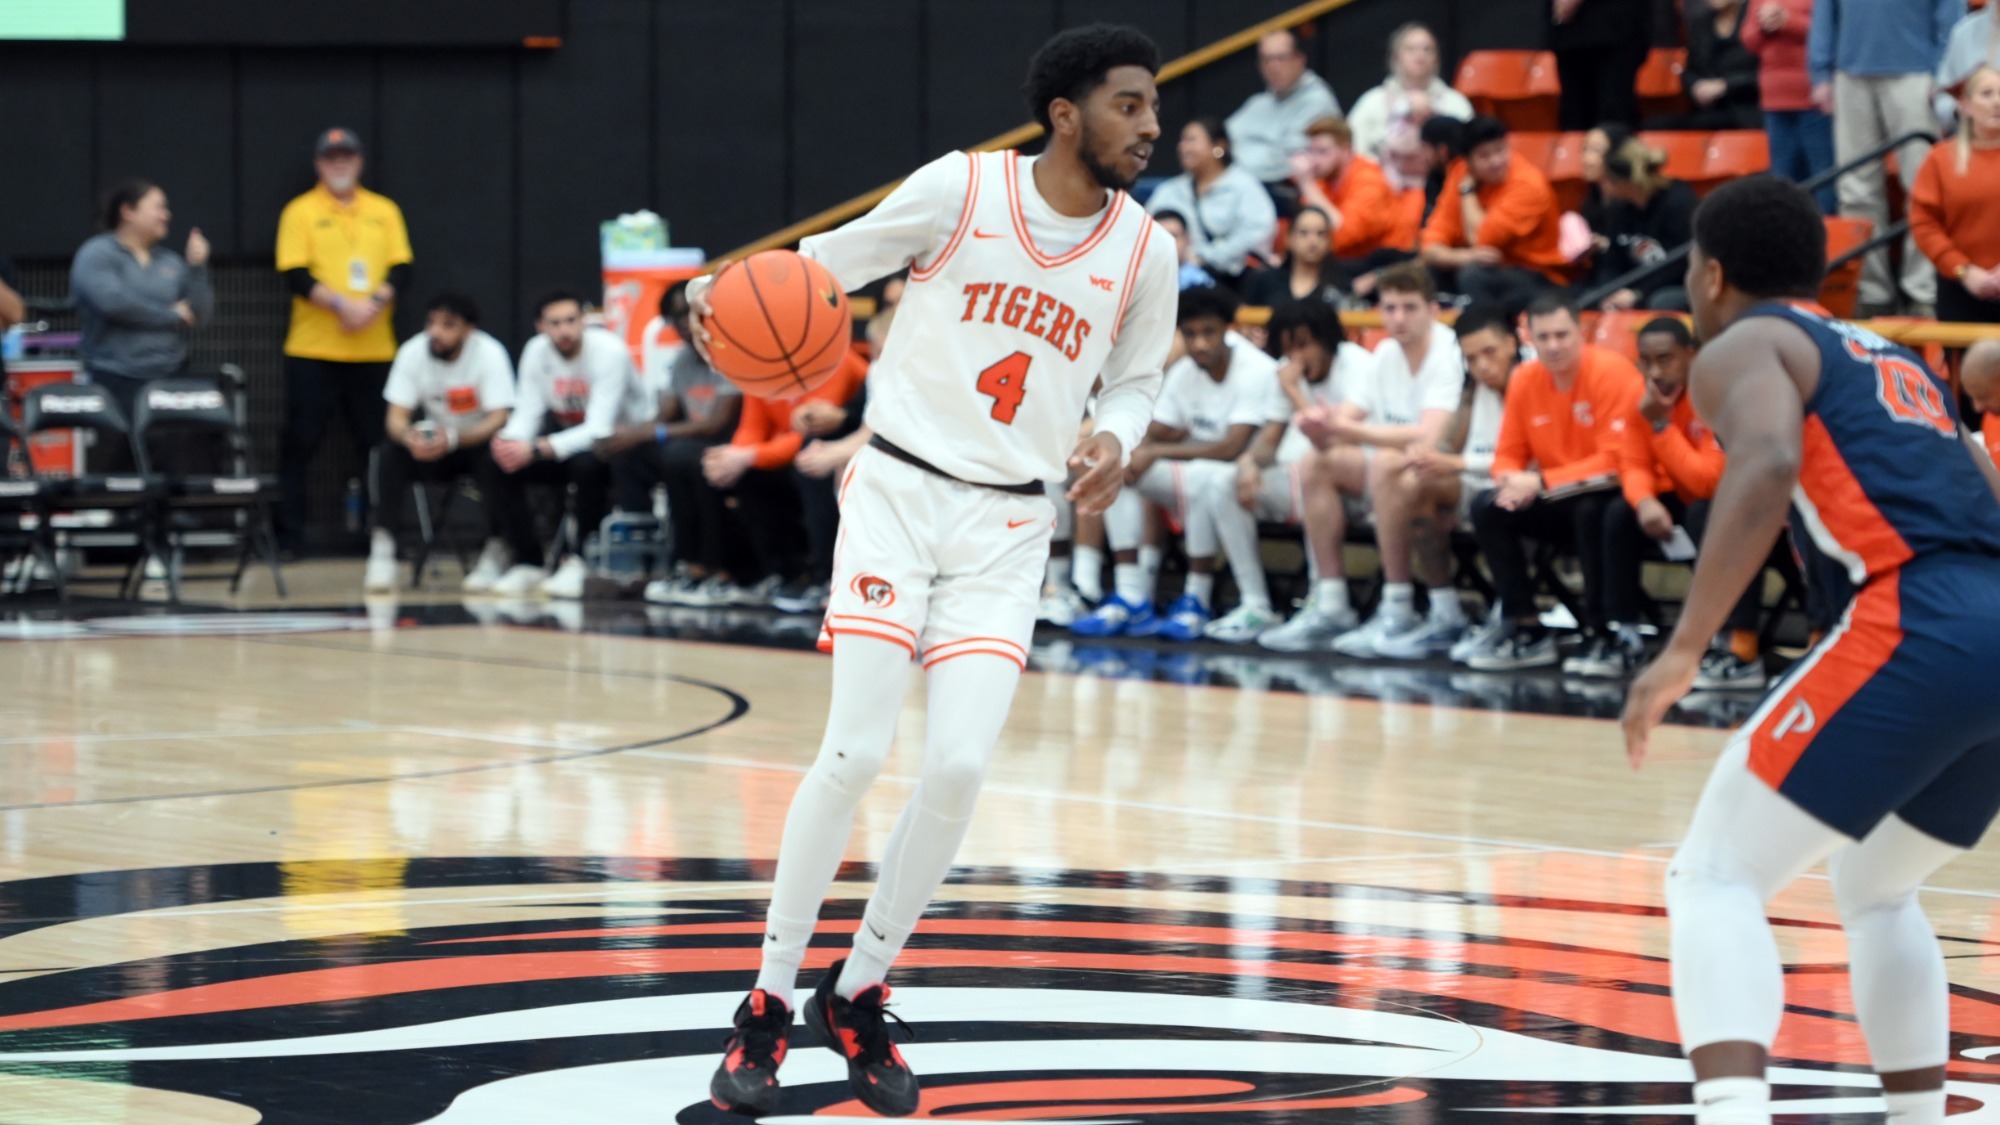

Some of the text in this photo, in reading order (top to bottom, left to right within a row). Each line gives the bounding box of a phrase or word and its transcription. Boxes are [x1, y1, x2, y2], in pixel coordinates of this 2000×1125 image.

[1088, 274, 1115, 292] WCC
[960, 282, 1092, 362] TIGERS
[976, 350, 1033, 425] 4
[1771, 696, 1816, 740] P
